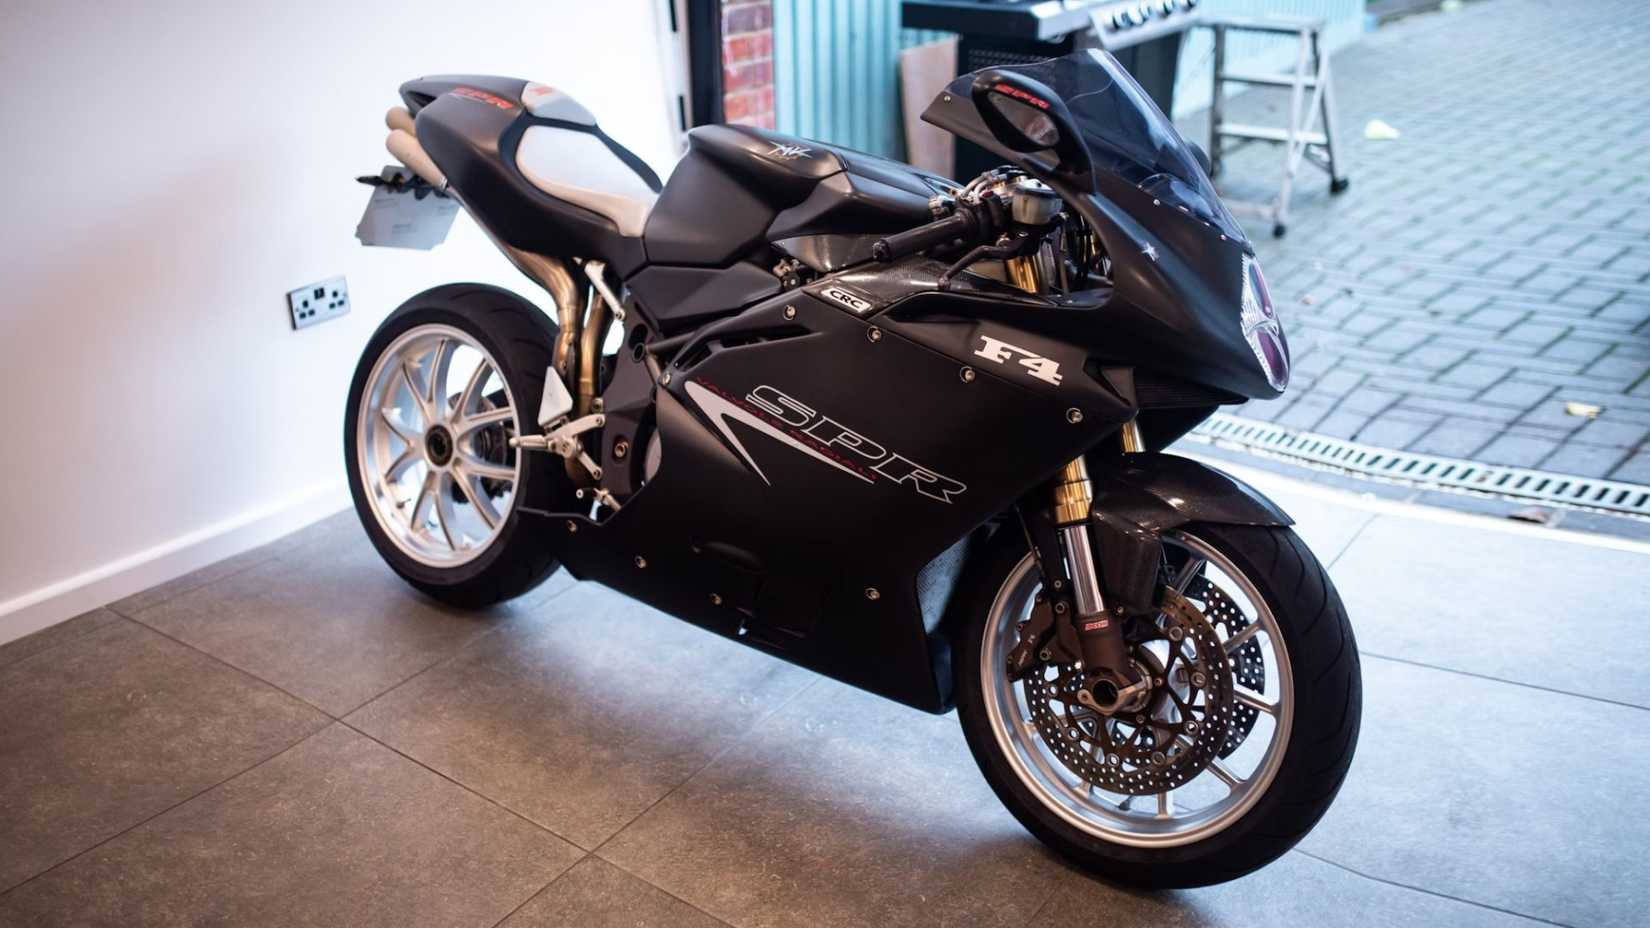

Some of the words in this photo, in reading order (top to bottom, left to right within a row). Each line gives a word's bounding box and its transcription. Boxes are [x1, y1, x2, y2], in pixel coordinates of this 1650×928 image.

[830, 290, 864, 309] CRC
[974, 335, 1063, 386] F4
[746, 385, 967, 504] SPR
